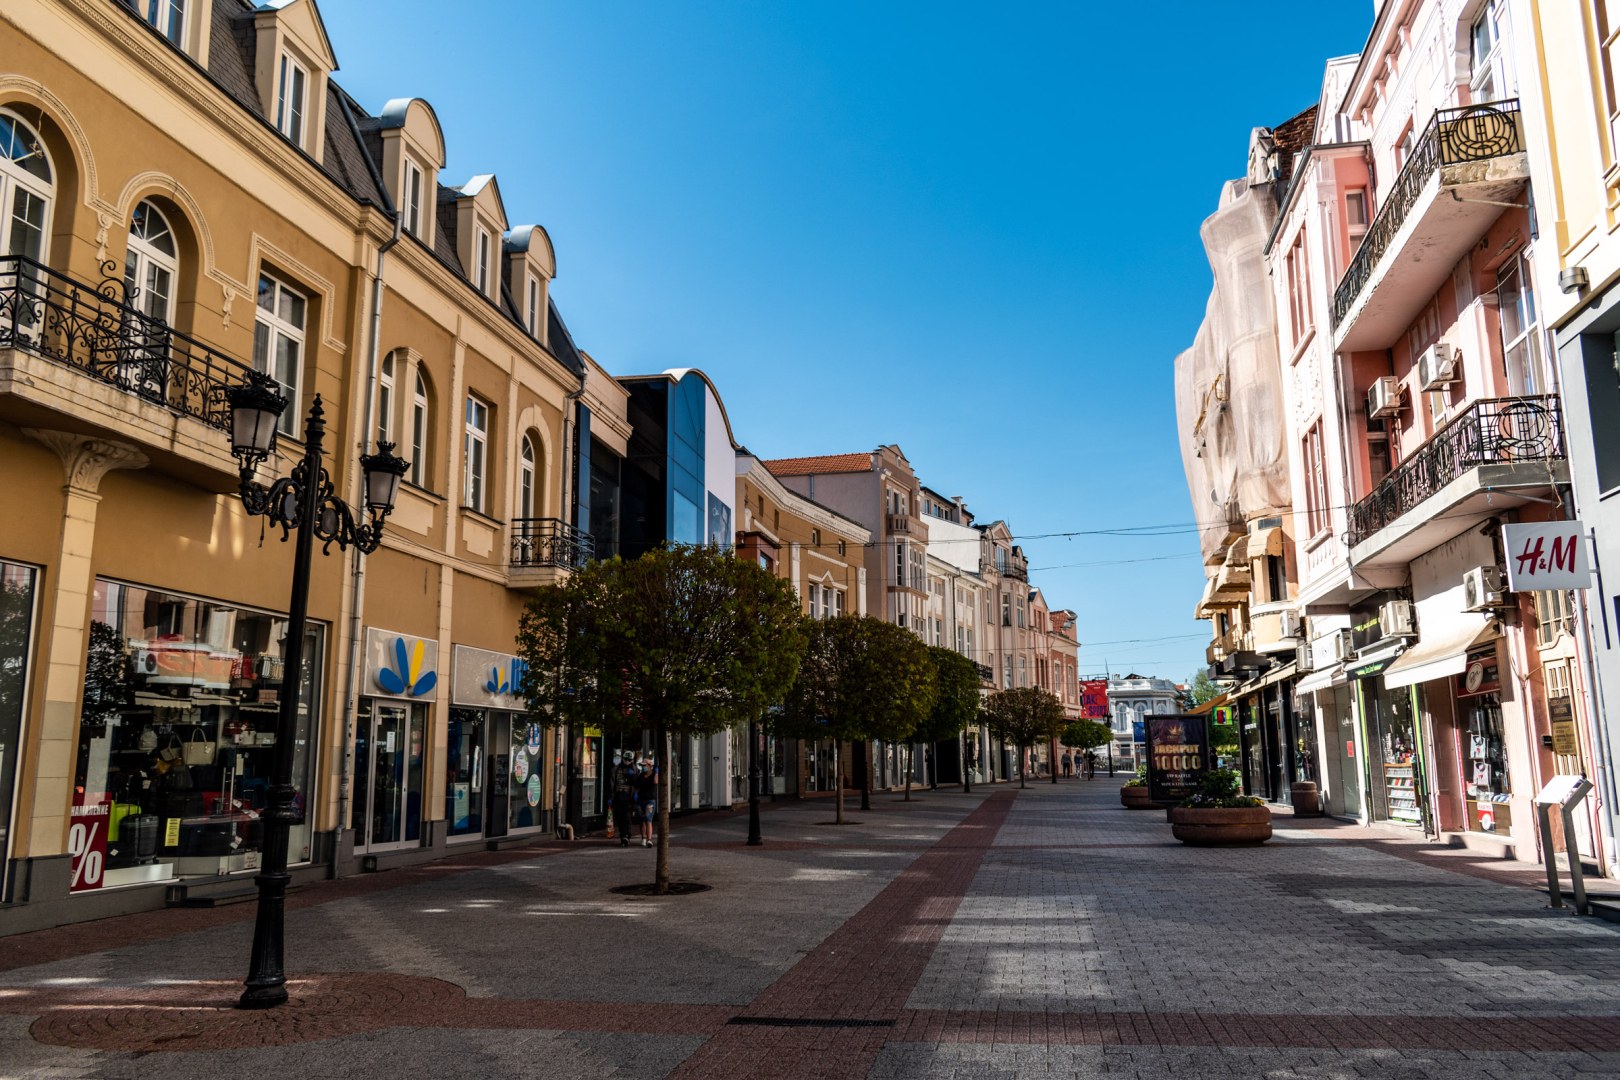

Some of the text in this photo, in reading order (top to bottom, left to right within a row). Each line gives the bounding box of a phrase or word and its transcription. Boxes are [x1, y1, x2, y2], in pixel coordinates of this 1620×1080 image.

[1516, 534, 1578, 576] H&M
[1154, 744, 1200, 753] JACKPOT
[68, 821, 102, 888] %
